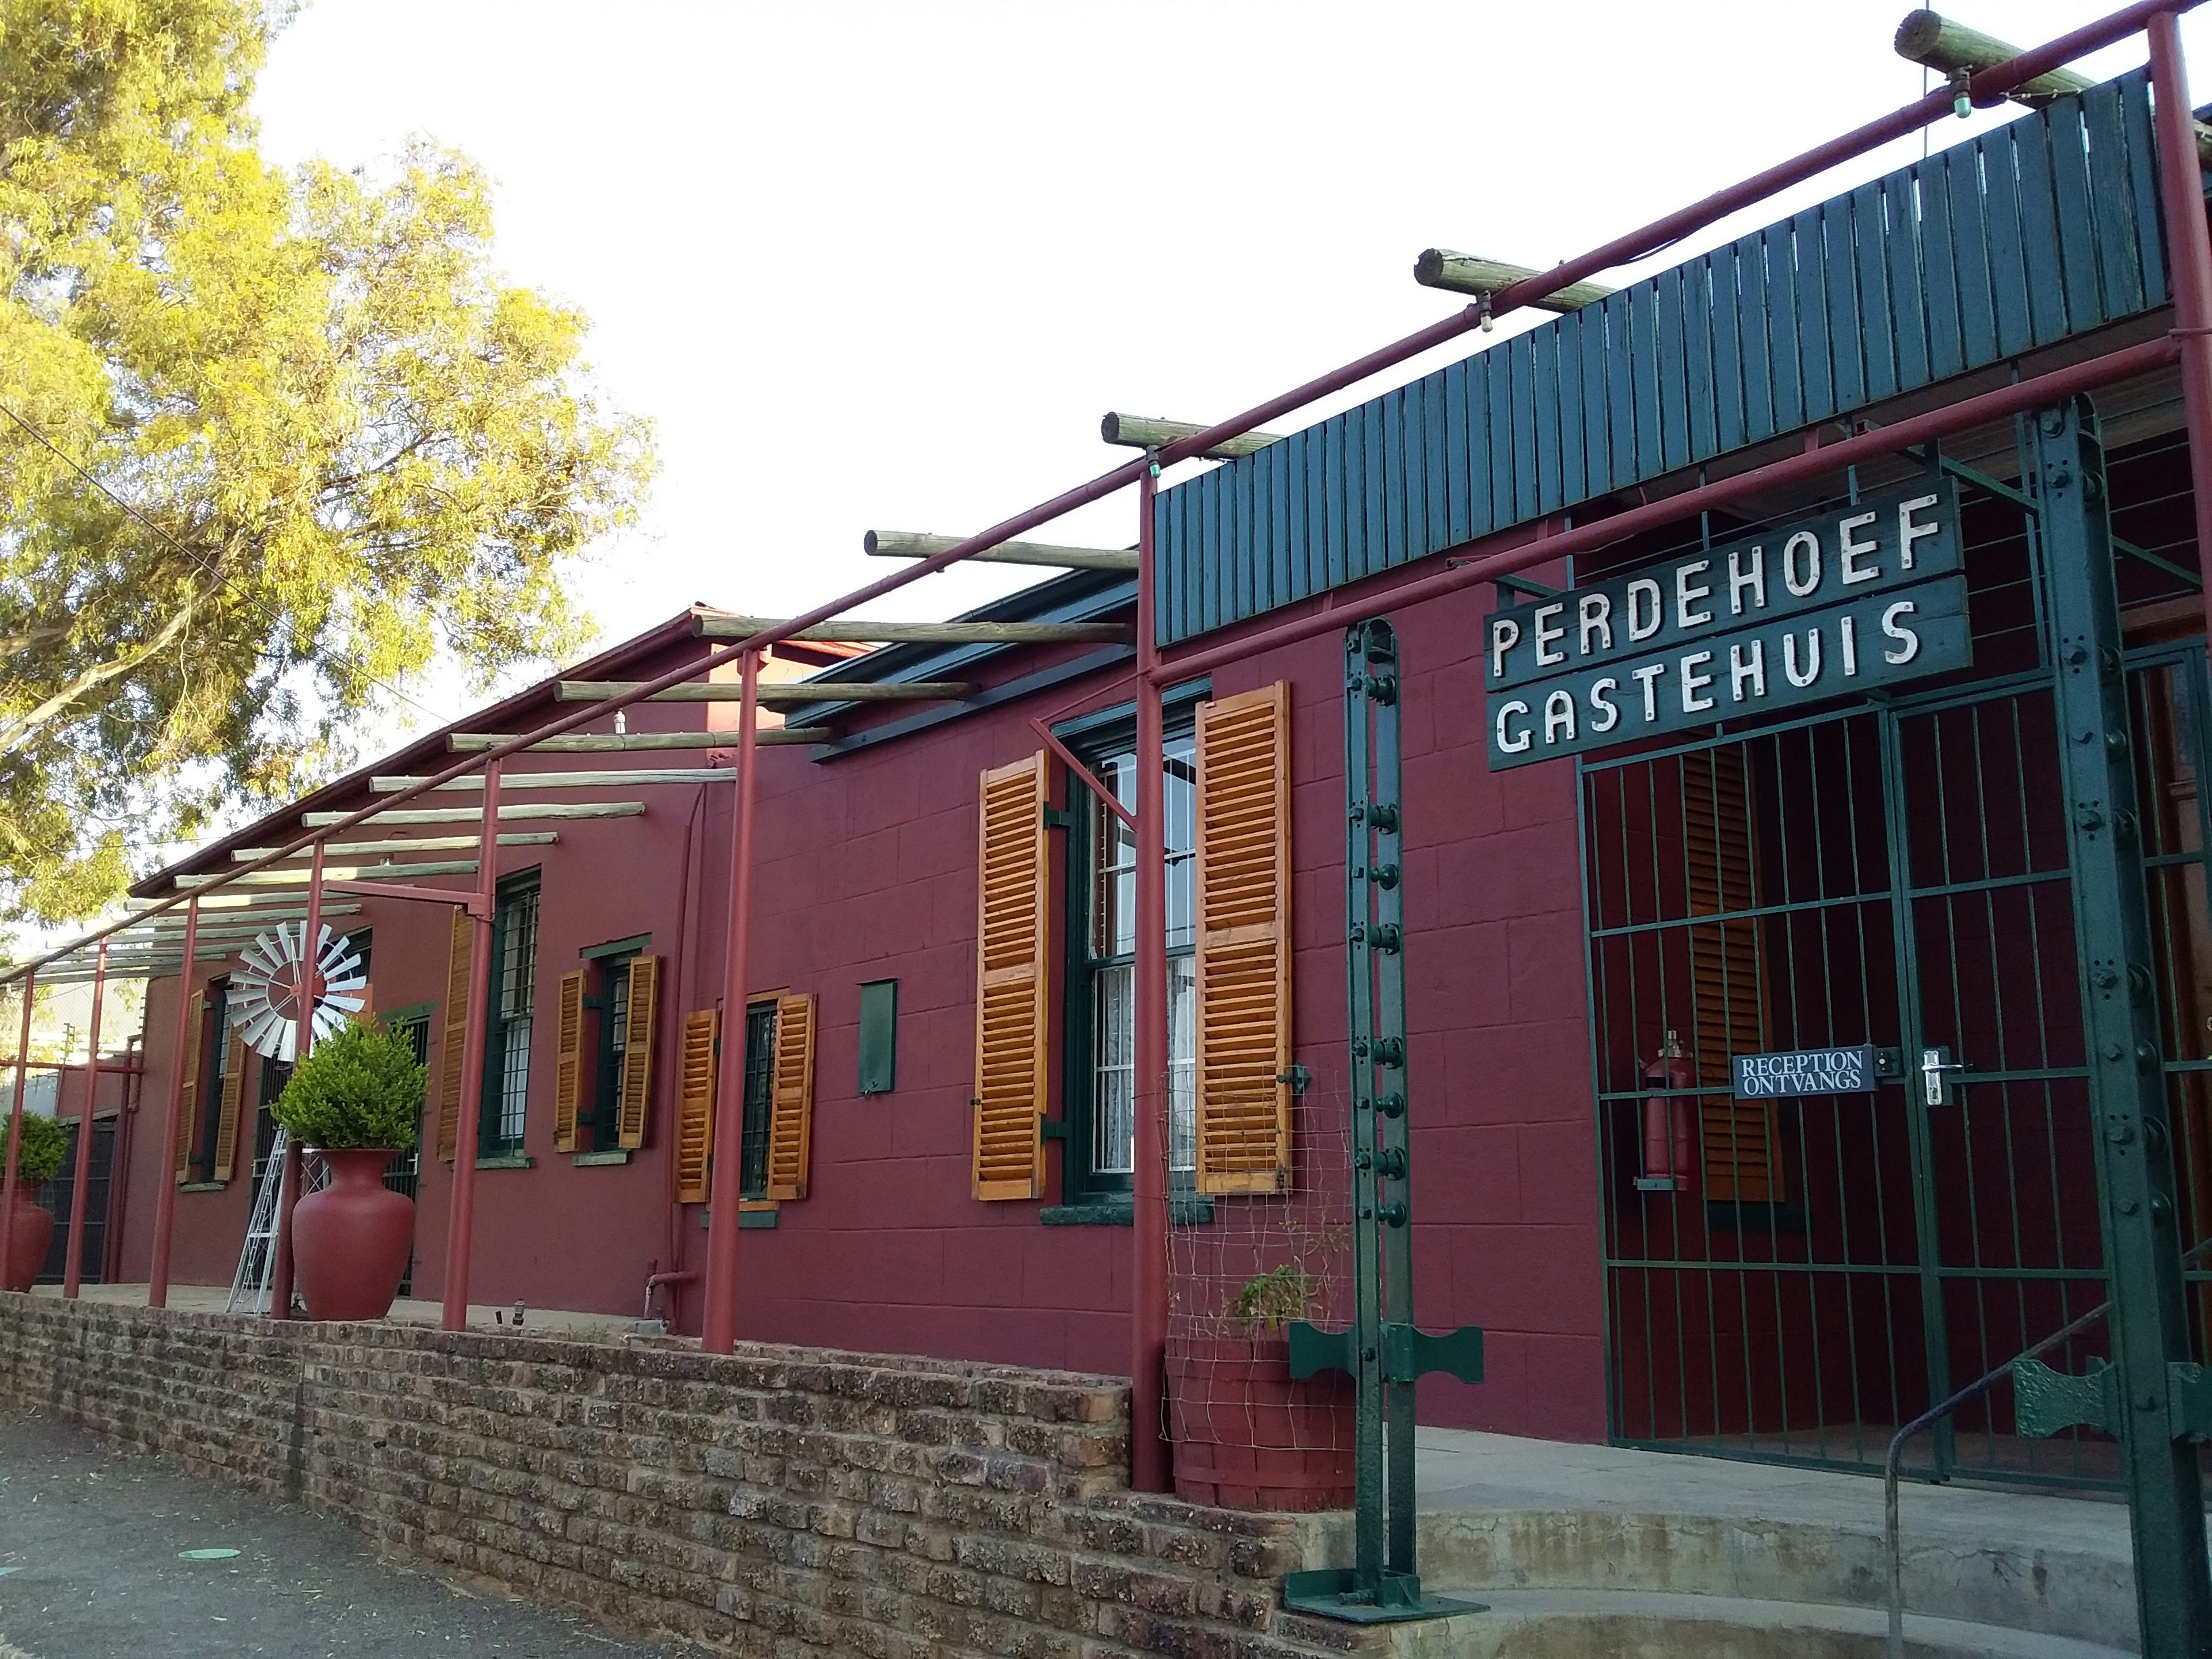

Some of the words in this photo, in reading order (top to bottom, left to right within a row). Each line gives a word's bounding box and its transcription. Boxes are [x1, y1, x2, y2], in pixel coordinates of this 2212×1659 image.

[1492, 494, 1939, 678] PERDEHOEF
[1496, 601, 1919, 754] GASTEHUIS
[1742, 1050, 1863, 1078] RECEPTION
[1744, 1069, 1862, 1096] ONTVANGS
